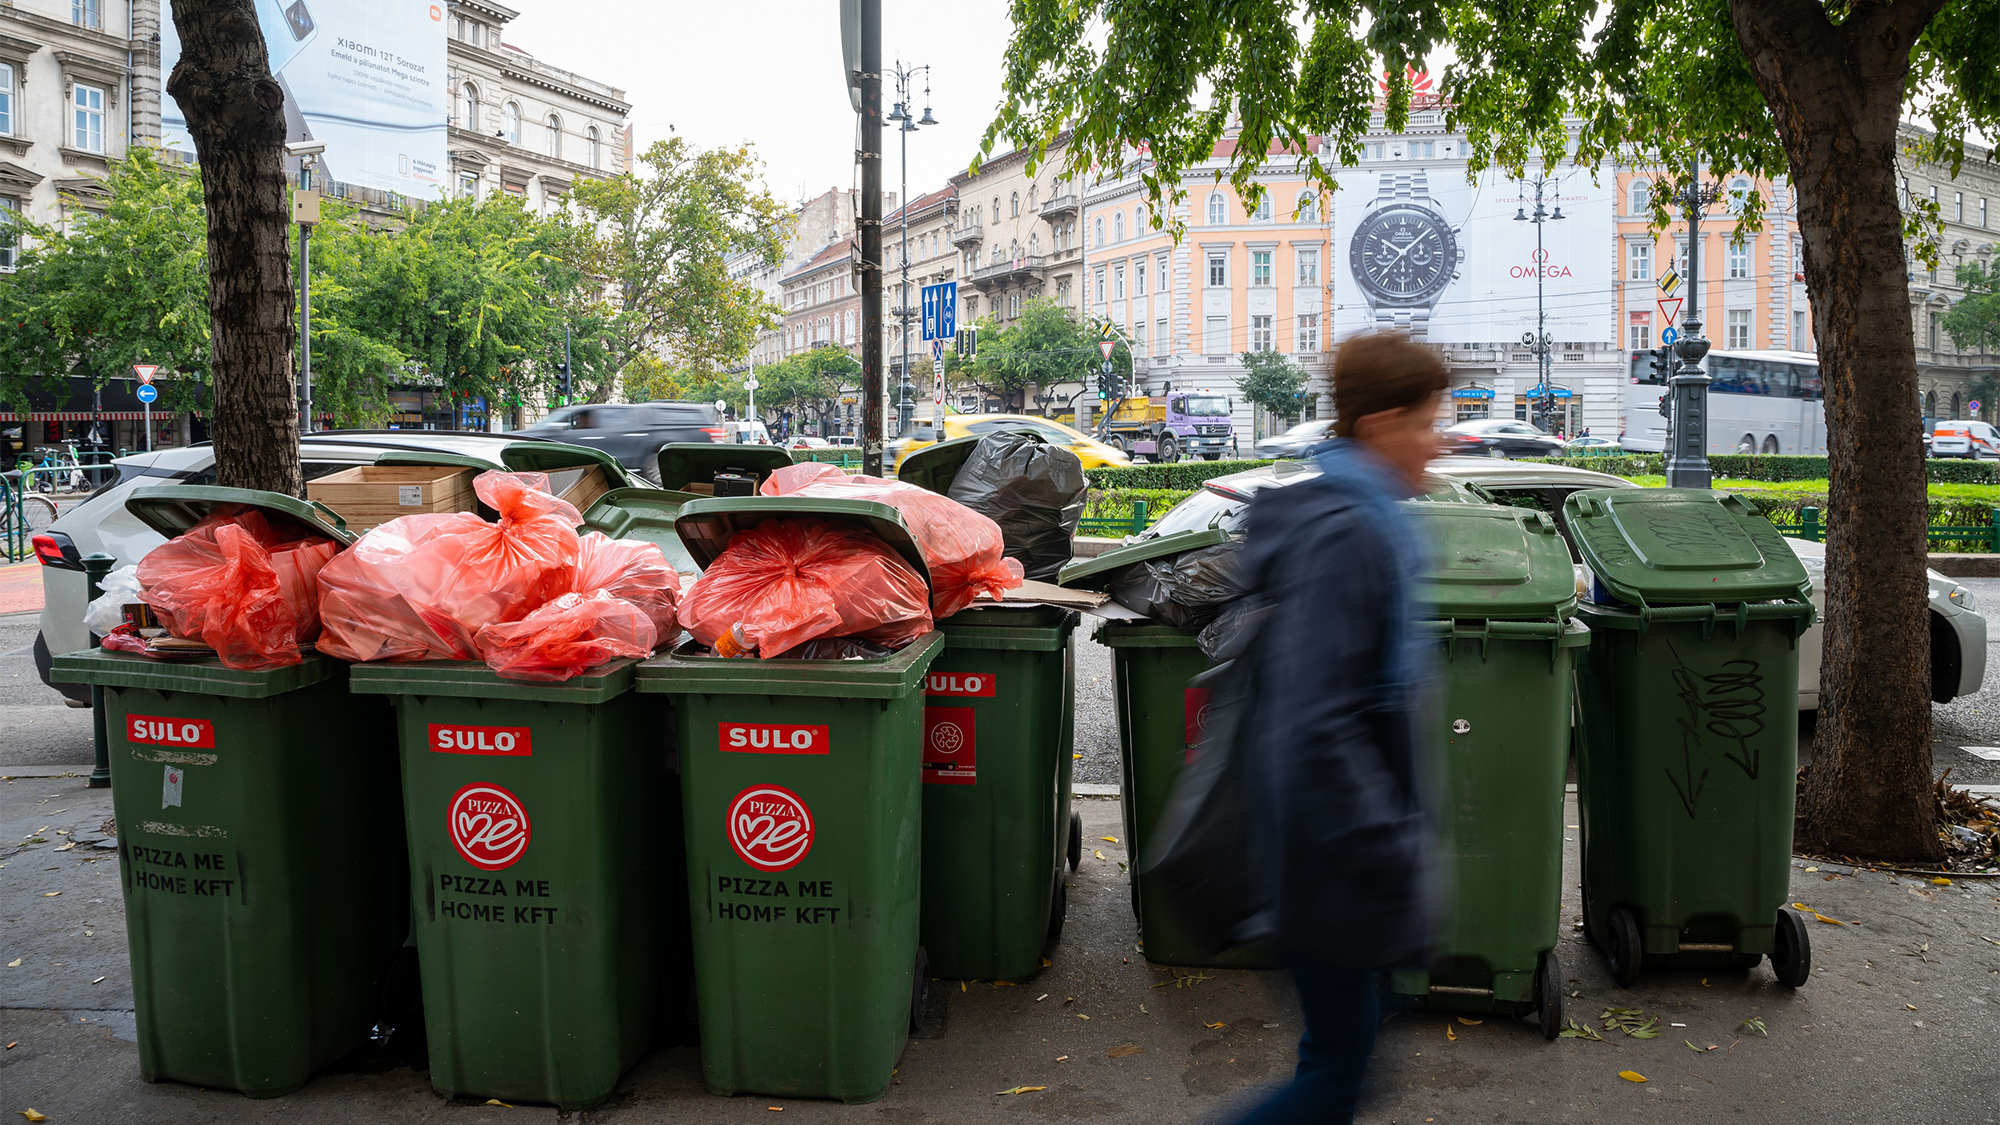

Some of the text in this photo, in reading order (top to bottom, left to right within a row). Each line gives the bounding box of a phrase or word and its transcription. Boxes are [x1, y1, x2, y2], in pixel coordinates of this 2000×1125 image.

[331, 49, 352, 62] Emeld
[359, 59, 391, 74] pillanatot
[391, 68, 408, 80] Mega
[409, 75, 430, 87] szintre
[380, 51, 393, 62] 12T
[396, 56, 425, 73] Sorozat
[1510, 266, 1572, 278] OMEGA
[467, 798, 512, 815] PIZZA
[749, 800, 796, 817] PIZZA
[132, 845, 225, 871] PIZZA ME
[136, 870, 234, 897] HOME KFT
[440, 874, 550, 897] PIZZA ME
[718, 876, 833, 898] PIZZA ME
[442, 901, 558, 925] HOME KFT
[718, 902, 841, 925] HOME KFT
